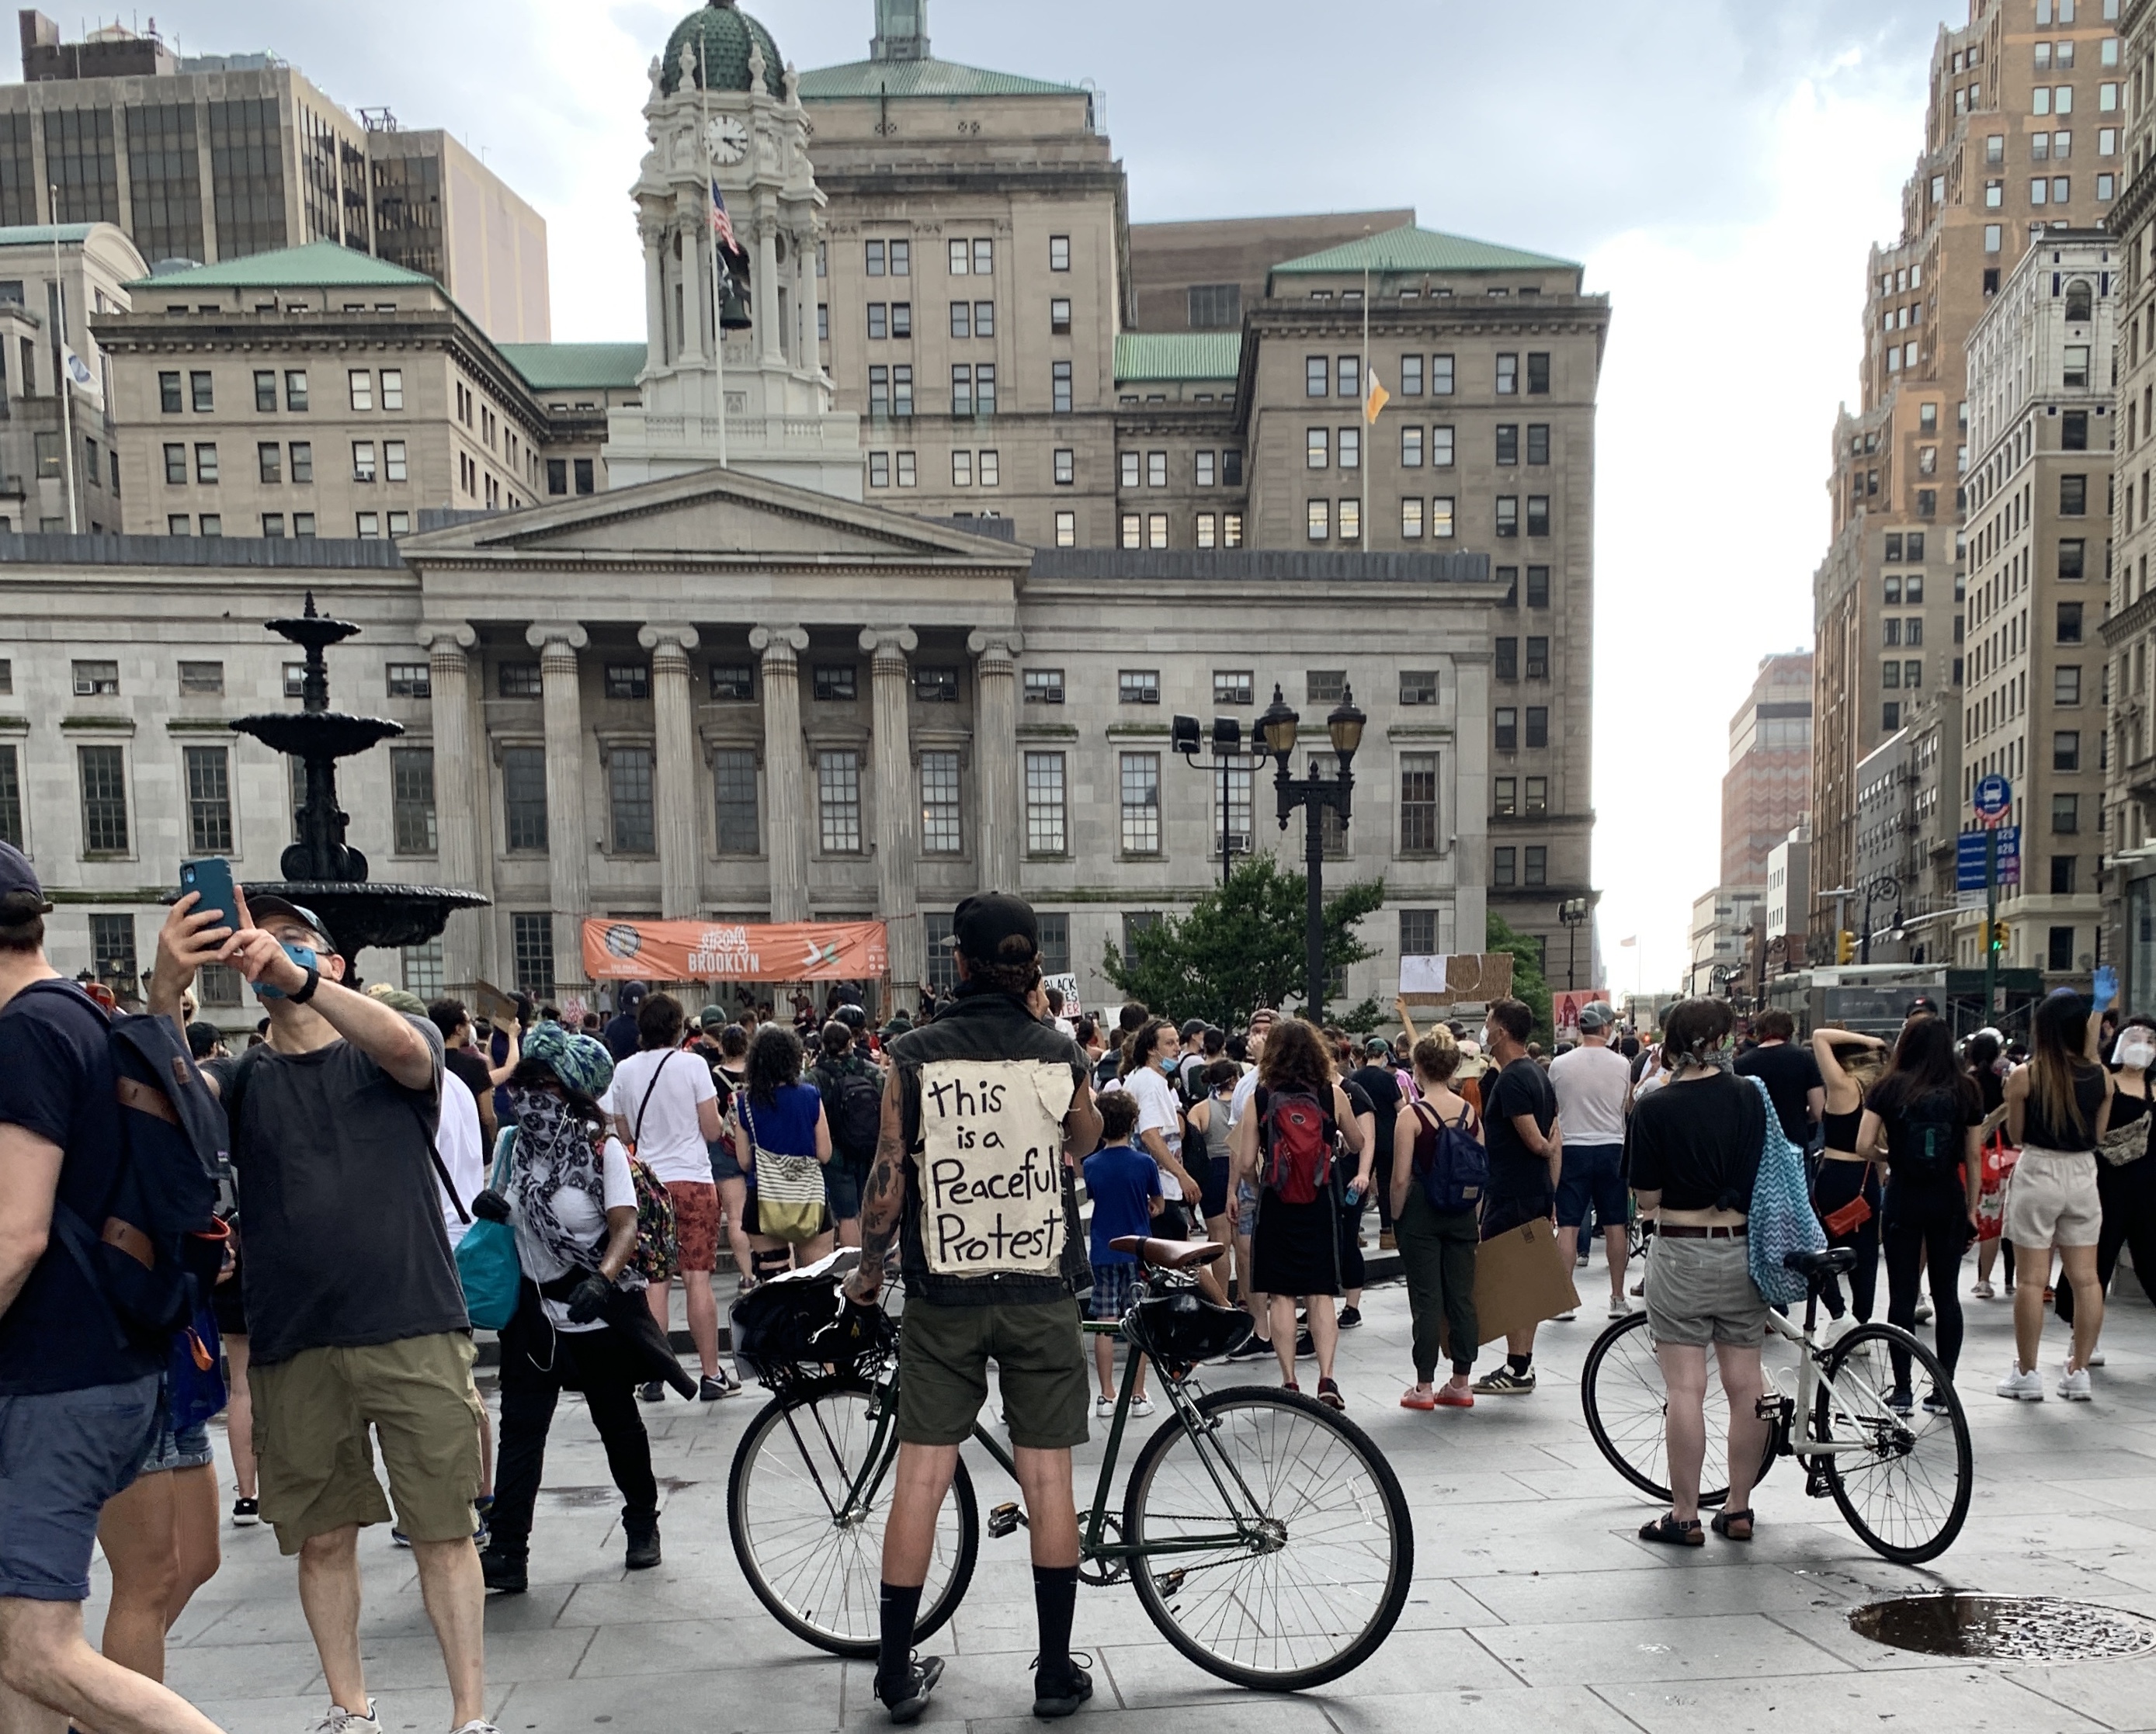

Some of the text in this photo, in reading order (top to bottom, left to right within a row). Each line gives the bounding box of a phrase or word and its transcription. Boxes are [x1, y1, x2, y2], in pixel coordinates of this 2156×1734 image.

[696, 925, 749, 955] STRONG
[688, 952, 759, 973] BROOKLYN
[1043, 977, 1076, 992] BLACK
[928, 1078, 1006, 1118] this
[956, 1125, 1005, 1150] is a
[932, 1145, 1057, 1209] Peaceful
[936, 1209, 1062, 1264] Protest
